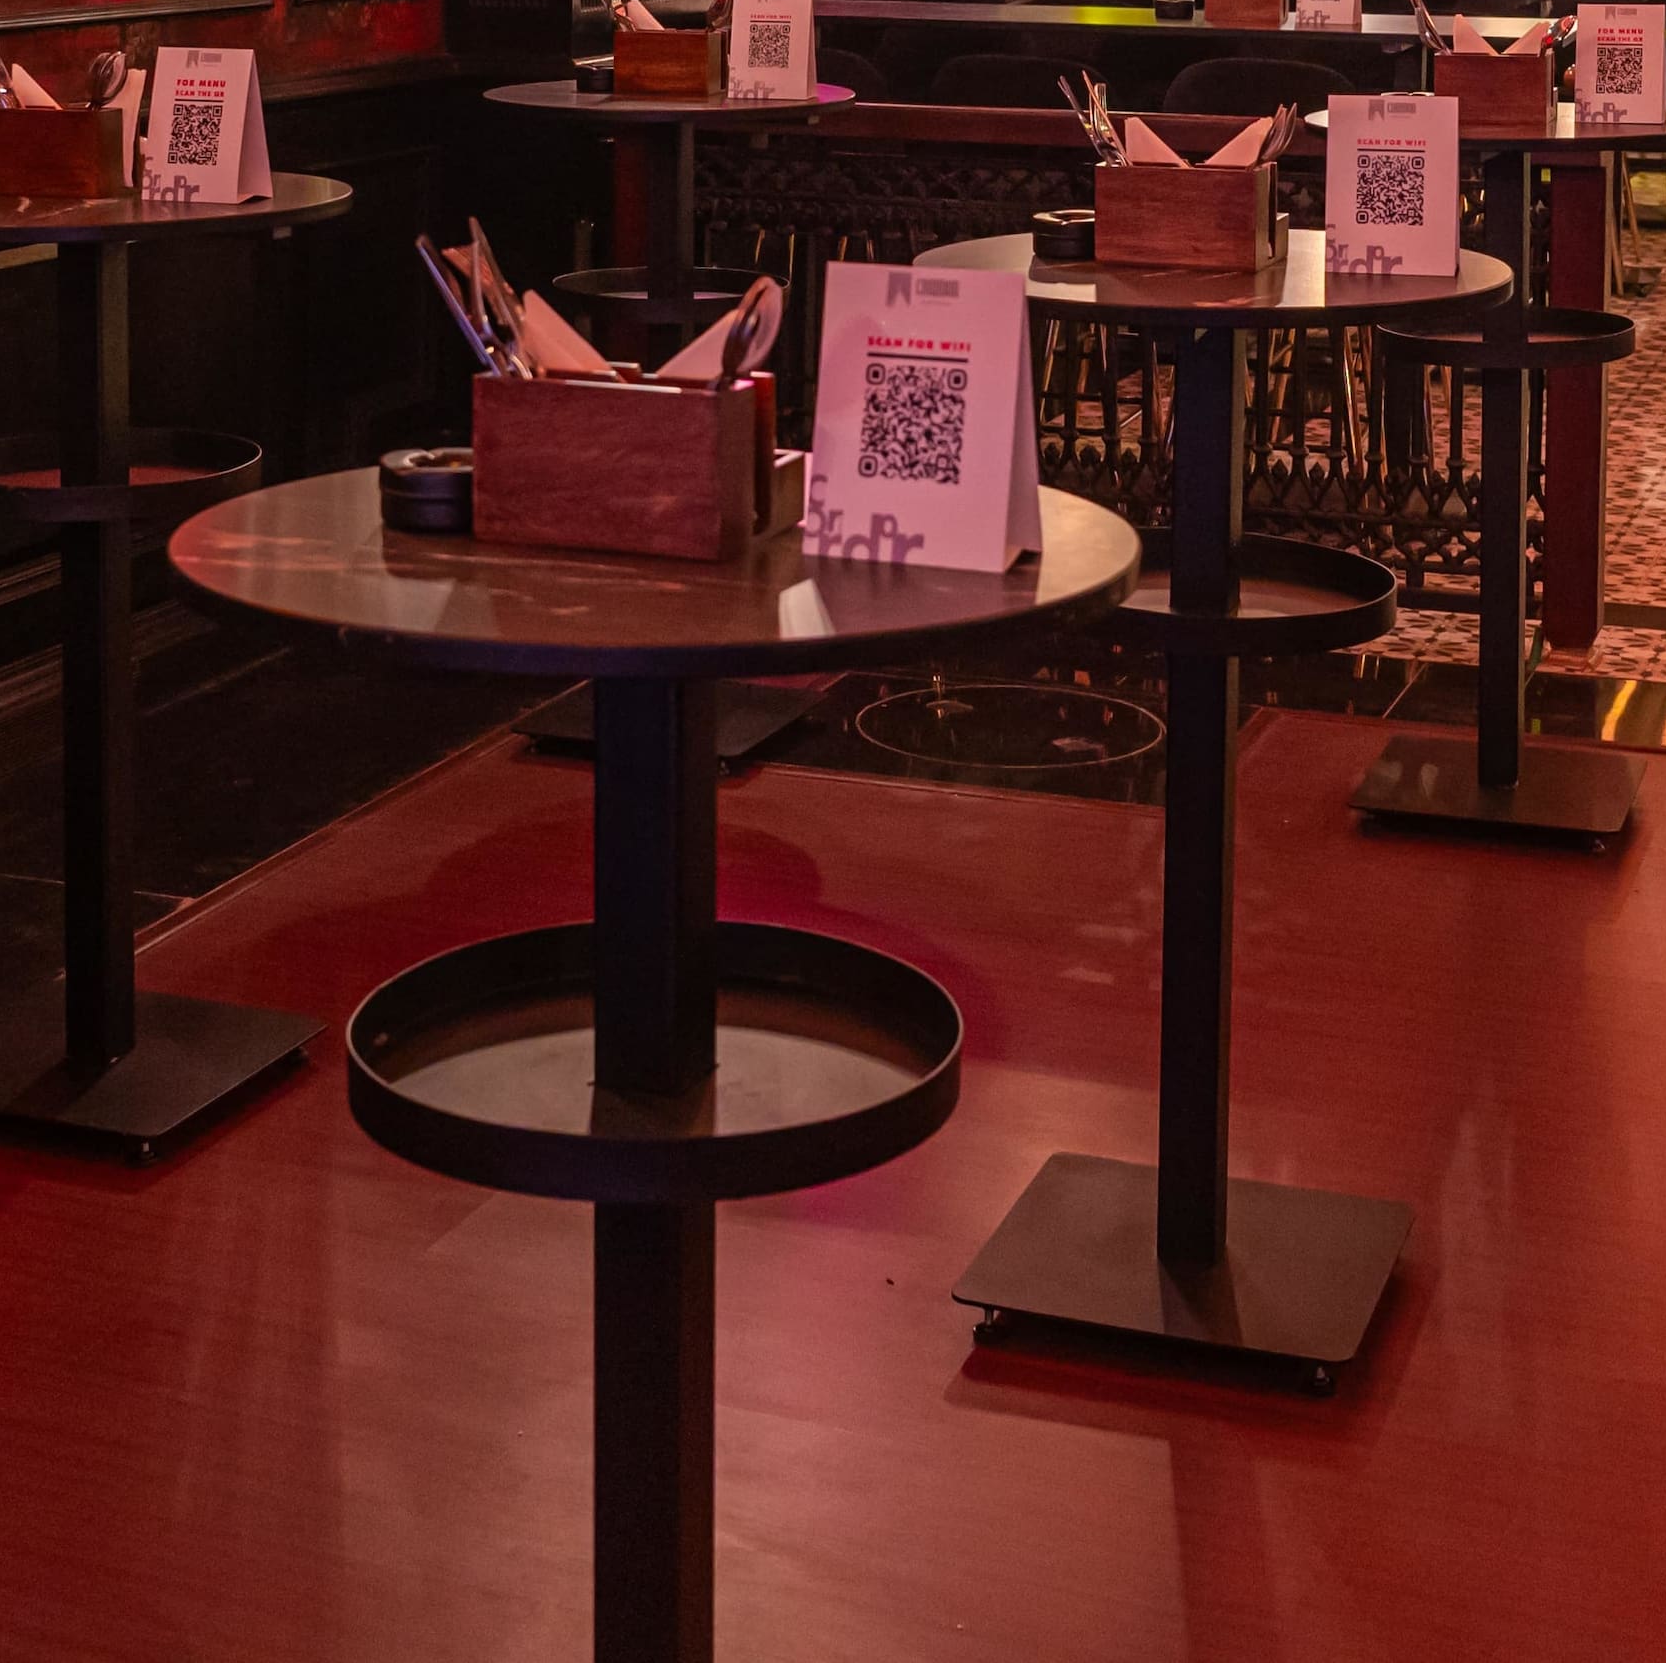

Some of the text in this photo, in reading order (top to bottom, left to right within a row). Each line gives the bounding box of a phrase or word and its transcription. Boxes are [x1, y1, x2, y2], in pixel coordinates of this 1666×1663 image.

[176, 79, 226, 88] FOR MENU
[1357, 138, 1381, 146] SCAN
[1404, 139, 1427, 147] WIFI
[867, 335, 972, 352] SCAN FOR WIFI
